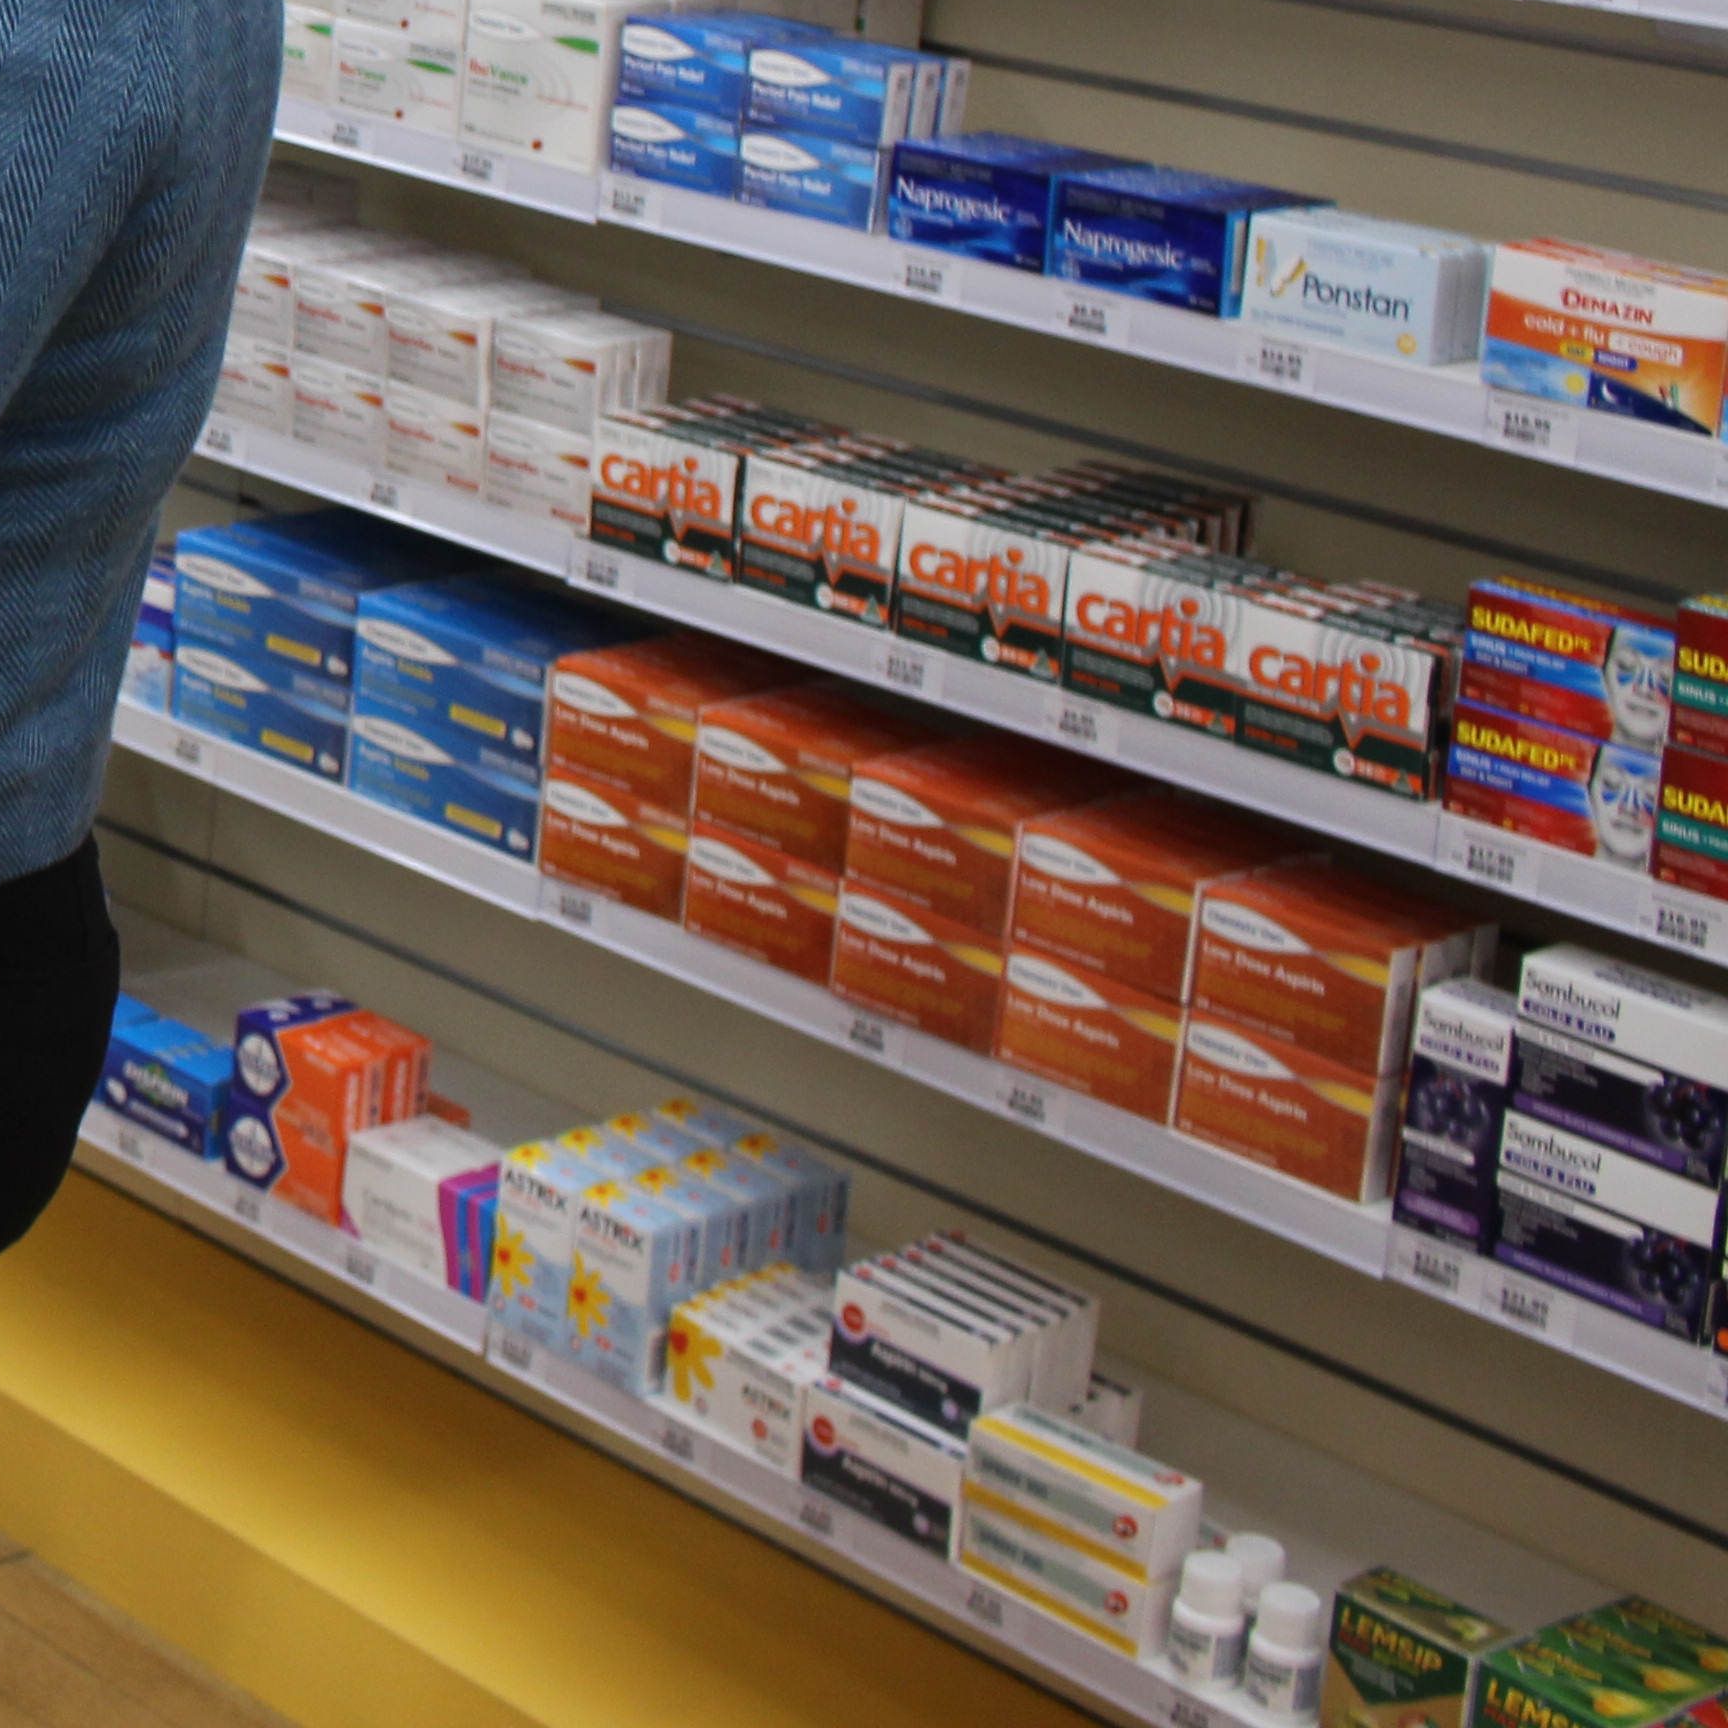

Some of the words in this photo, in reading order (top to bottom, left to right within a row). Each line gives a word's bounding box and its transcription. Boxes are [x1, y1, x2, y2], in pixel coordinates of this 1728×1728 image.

[897, 175, 1011, 225] Naprogesic
[1063, 218, 1185, 270] Naprogesic
[1302, 272, 1412, 322] Ponstan
[1560, 287, 1654, 326] DEMAZIN
[1524, 312, 1566, 338] cold
[1583, 320, 1606, 346] flu
[600, 452, 722, 520] cartia
[749, 492, 881, 564] cartia
[908, 541, 1051, 617] cartia
[1075, 591, 1227, 670] cartia
[1471, 605, 1574, 652] SUDAFED
[1471, 635, 1506, 656] SINUS
[1247, 645, 1410, 731] cartia
[1678, 646, 1728, 680] SUDA
[1679, 681, 1717, 705] SINUS
[1663, 821, 1699, 842] SINUS
[1021, 873, 1047, 893] Low
[1051, 882, 1083, 905] Dose
[1088, 896, 1134, 925] Aspirin
[1203, 939, 1230, 962] Low
[1235, 949, 1271, 973] Dose
[1275, 965, 1325, 996] Aspirin
[1008, 994, 1034, 1015] Low
[1037, 1005, 1069, 1029] Dose
[1073, 1019, 1119, 1049] Aspirin
[1526, 970, 1622, 1021] Sambucol
[1424, 1008, 1506, 1054] Sambucol
[1187, 1061, 1214, 1083] Low
[1219, 1074, 1254, 1098] Dose
[1258, 1090, 1308, 1122] Aspirin
[1508, 1121, 1602, 1175] Sambucol
[1341, 1606, 1443, 1672] LEMSIP
